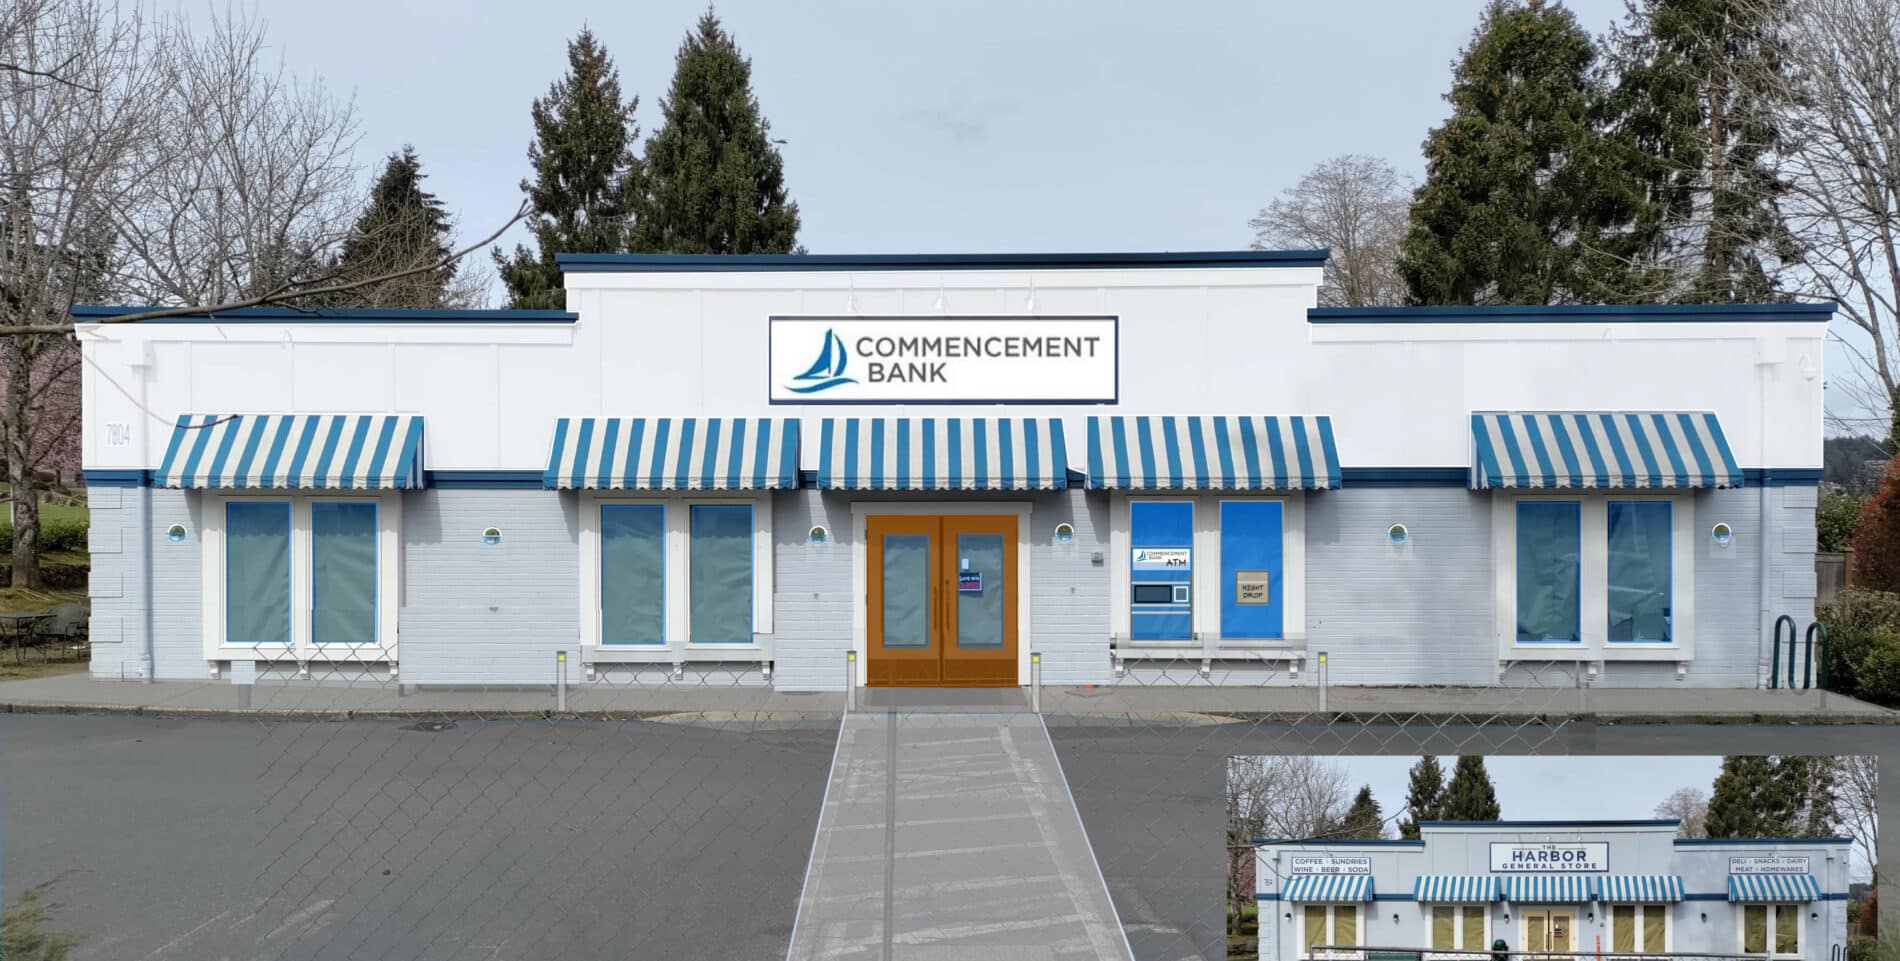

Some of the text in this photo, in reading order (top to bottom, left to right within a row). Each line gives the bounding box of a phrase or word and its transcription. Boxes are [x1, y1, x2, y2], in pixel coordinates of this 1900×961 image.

[856, 336, 1100, 358] COMMENCEMENT
[868, 361, 947, 383] BANK
[105, 423, 130, 446] 7804
[1166, 558, 1187, 567] ATM
[1512, 850, 1587, 862] HARBOR
